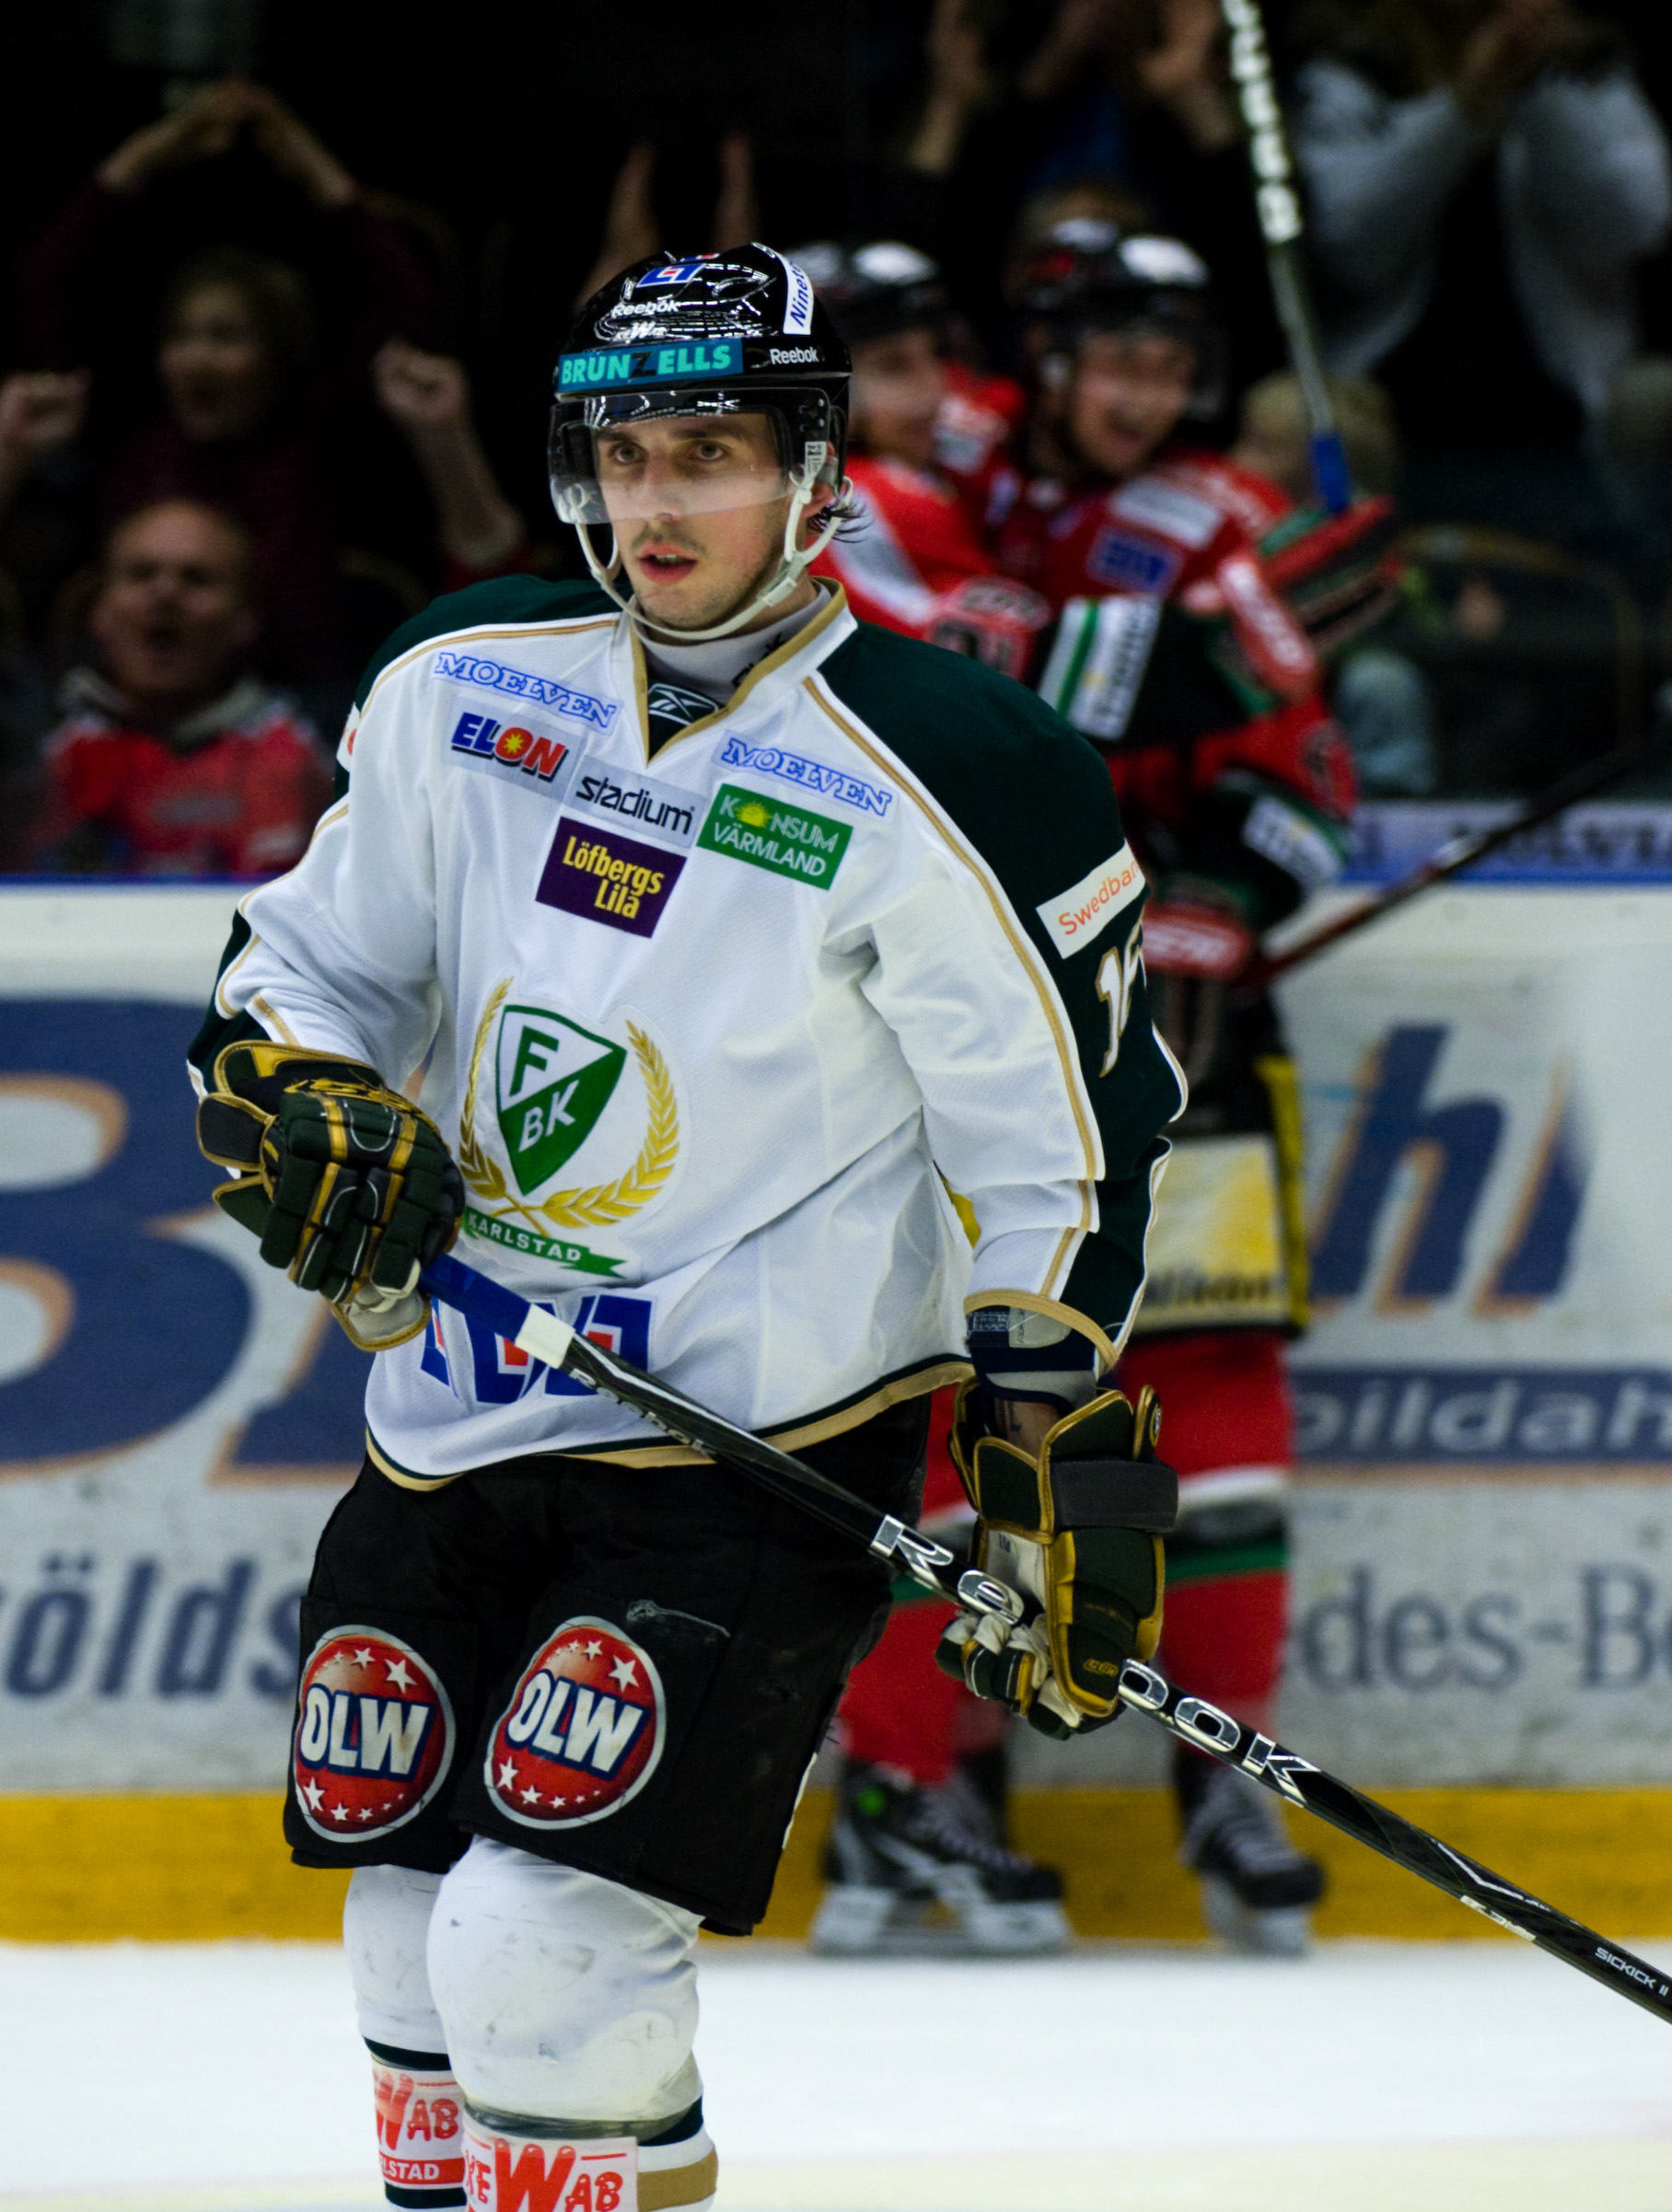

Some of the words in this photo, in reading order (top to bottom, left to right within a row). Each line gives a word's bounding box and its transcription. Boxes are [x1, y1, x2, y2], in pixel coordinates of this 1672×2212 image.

[611, 300, 679, 319] Reebok
[561, 344, 732, 385] BRUNZELLS
[769, 346, 819, 365] Reebok
[435, 652, 617, 729] MOELVEN
[451, 712, 568, 781] ELON
[720, 738, 893, 816] MOELVEN
[575, 770, 694, 835] stadium
[562, 835, 665, 897] Löfbergs
[714, 822, 826, 877] VÄRMLAND
[594, 878, 640, 919] Lila
[1058, 858, 1140, 936] Swedban
[467, 1211, 582, 1262] KARLSTAD
[2, 1551, 301, 1700] ölds
[300, 1685, 431, 1780] OLW
[506, 1669, 644, 1775] OLW
[1595, 1946, 1657, 1989] SICKICK
